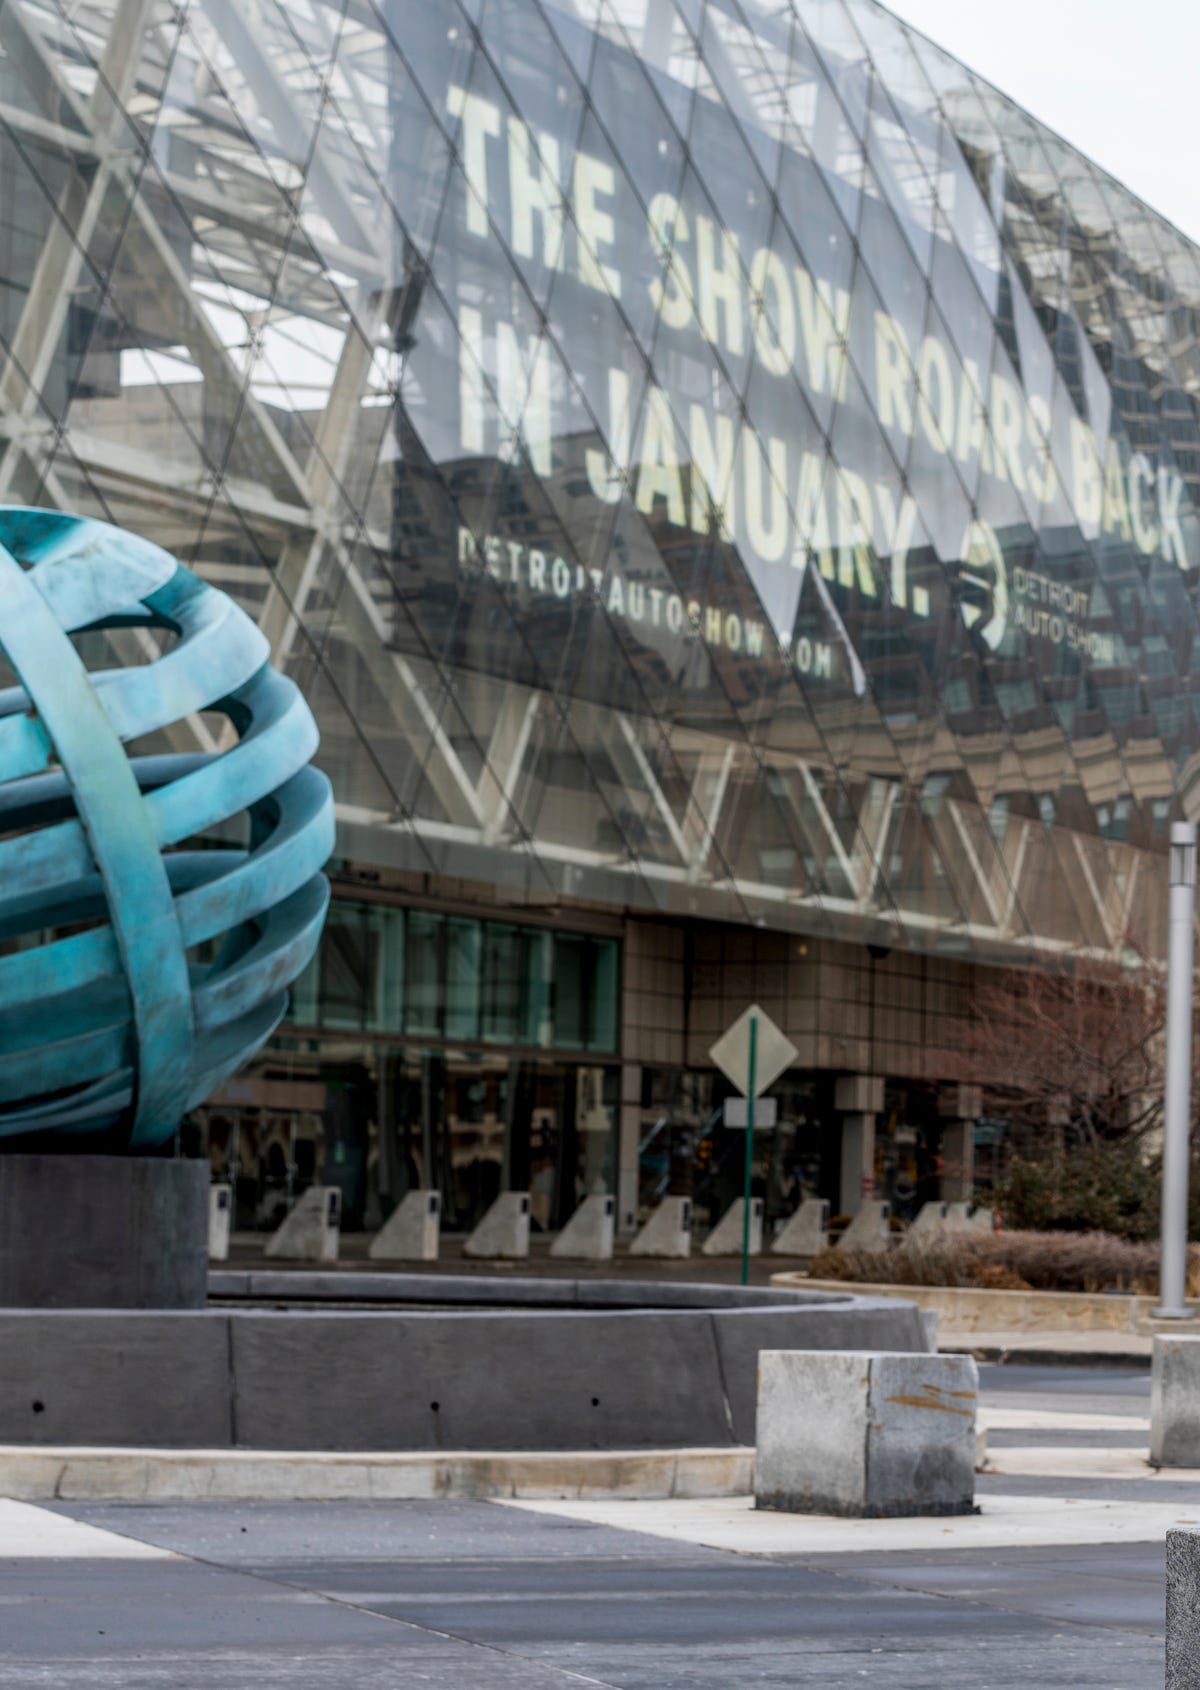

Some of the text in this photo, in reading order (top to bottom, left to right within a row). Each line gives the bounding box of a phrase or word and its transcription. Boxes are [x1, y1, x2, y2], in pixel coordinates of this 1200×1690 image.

[447, 83, 1189, 572] THE SHOW ROARS BACK
[459, 304, 930, 617] IN JANUARY.
[1013, 566, 1088, 619] DETROIT
[1014, 603, 1064, 644] AUTO
